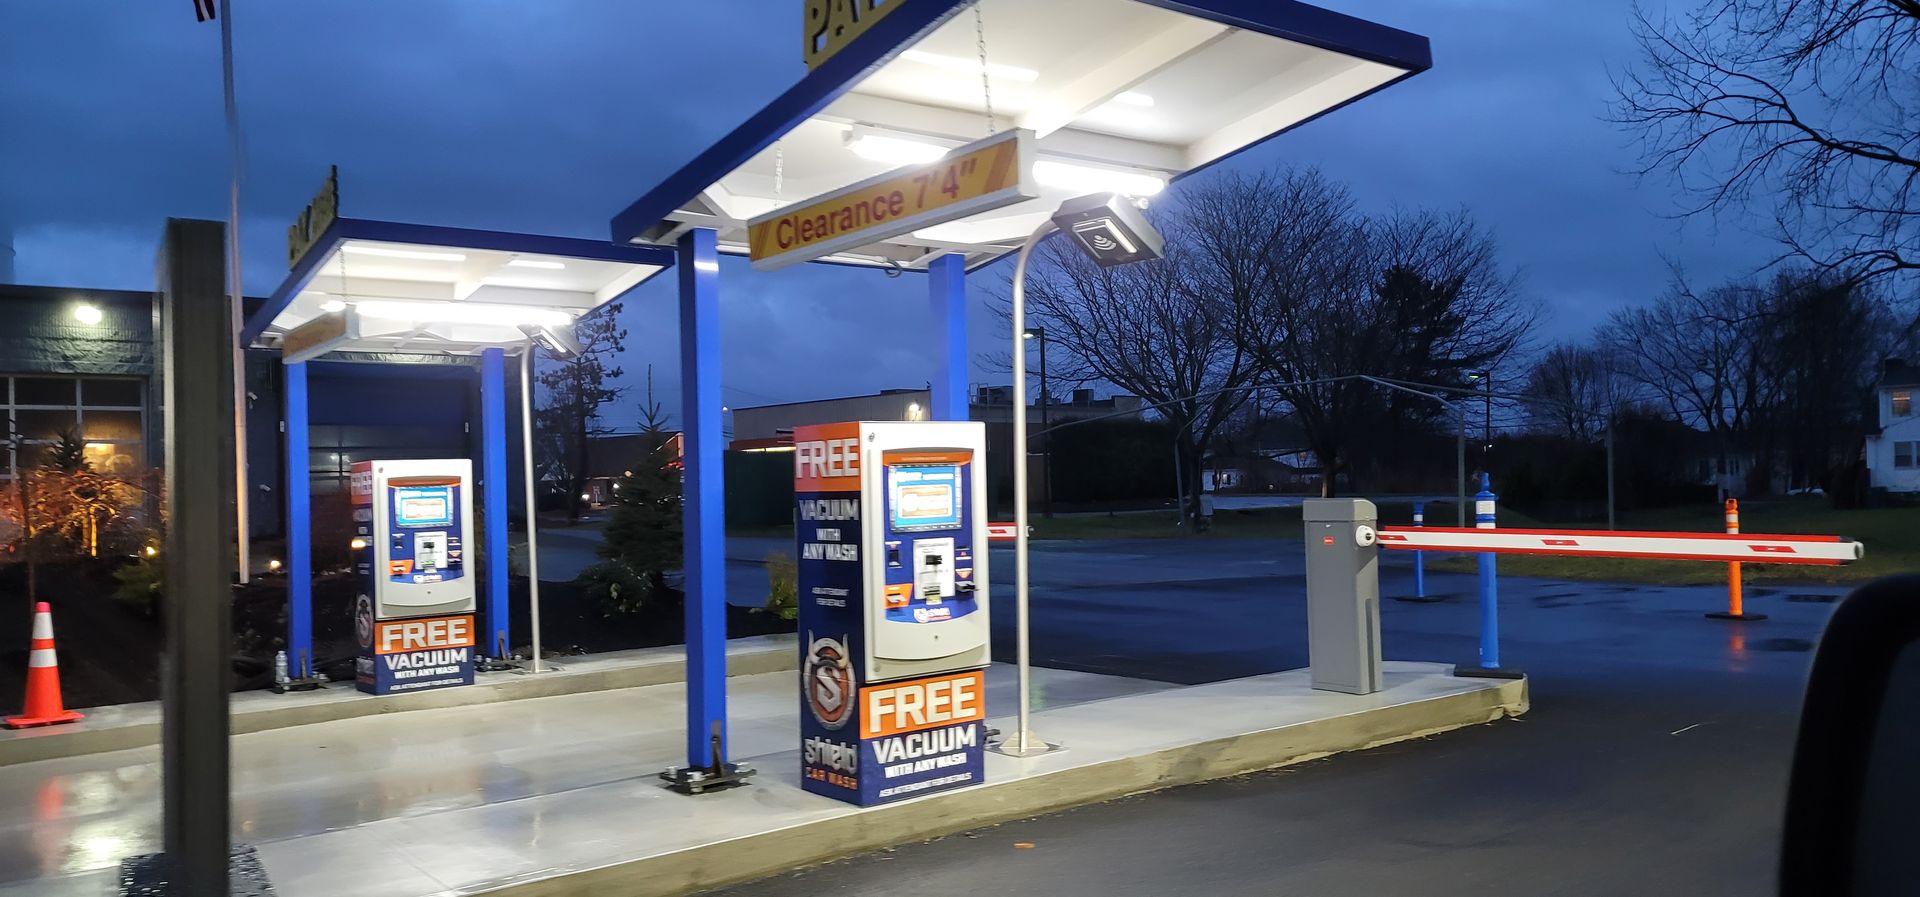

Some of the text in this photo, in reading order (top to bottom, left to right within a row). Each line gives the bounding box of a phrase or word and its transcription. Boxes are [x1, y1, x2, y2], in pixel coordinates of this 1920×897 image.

[776, 188, 905, 249] Clearance
[796, 438, 859, 478] FREE
[799, 499, 859, 520] VACUUM
[816, 528, 841, 541] WITH
[803, 543, 858, 561] ANY WASH
[382, 618, 468, 651] FREE
[384, 648, 467, 670] VACUUM
[869, 677, 976, 733] FREE
[872, 724, 976, 764] VACUUM
[884, 752, 967, 779] WITH ANY WASH
